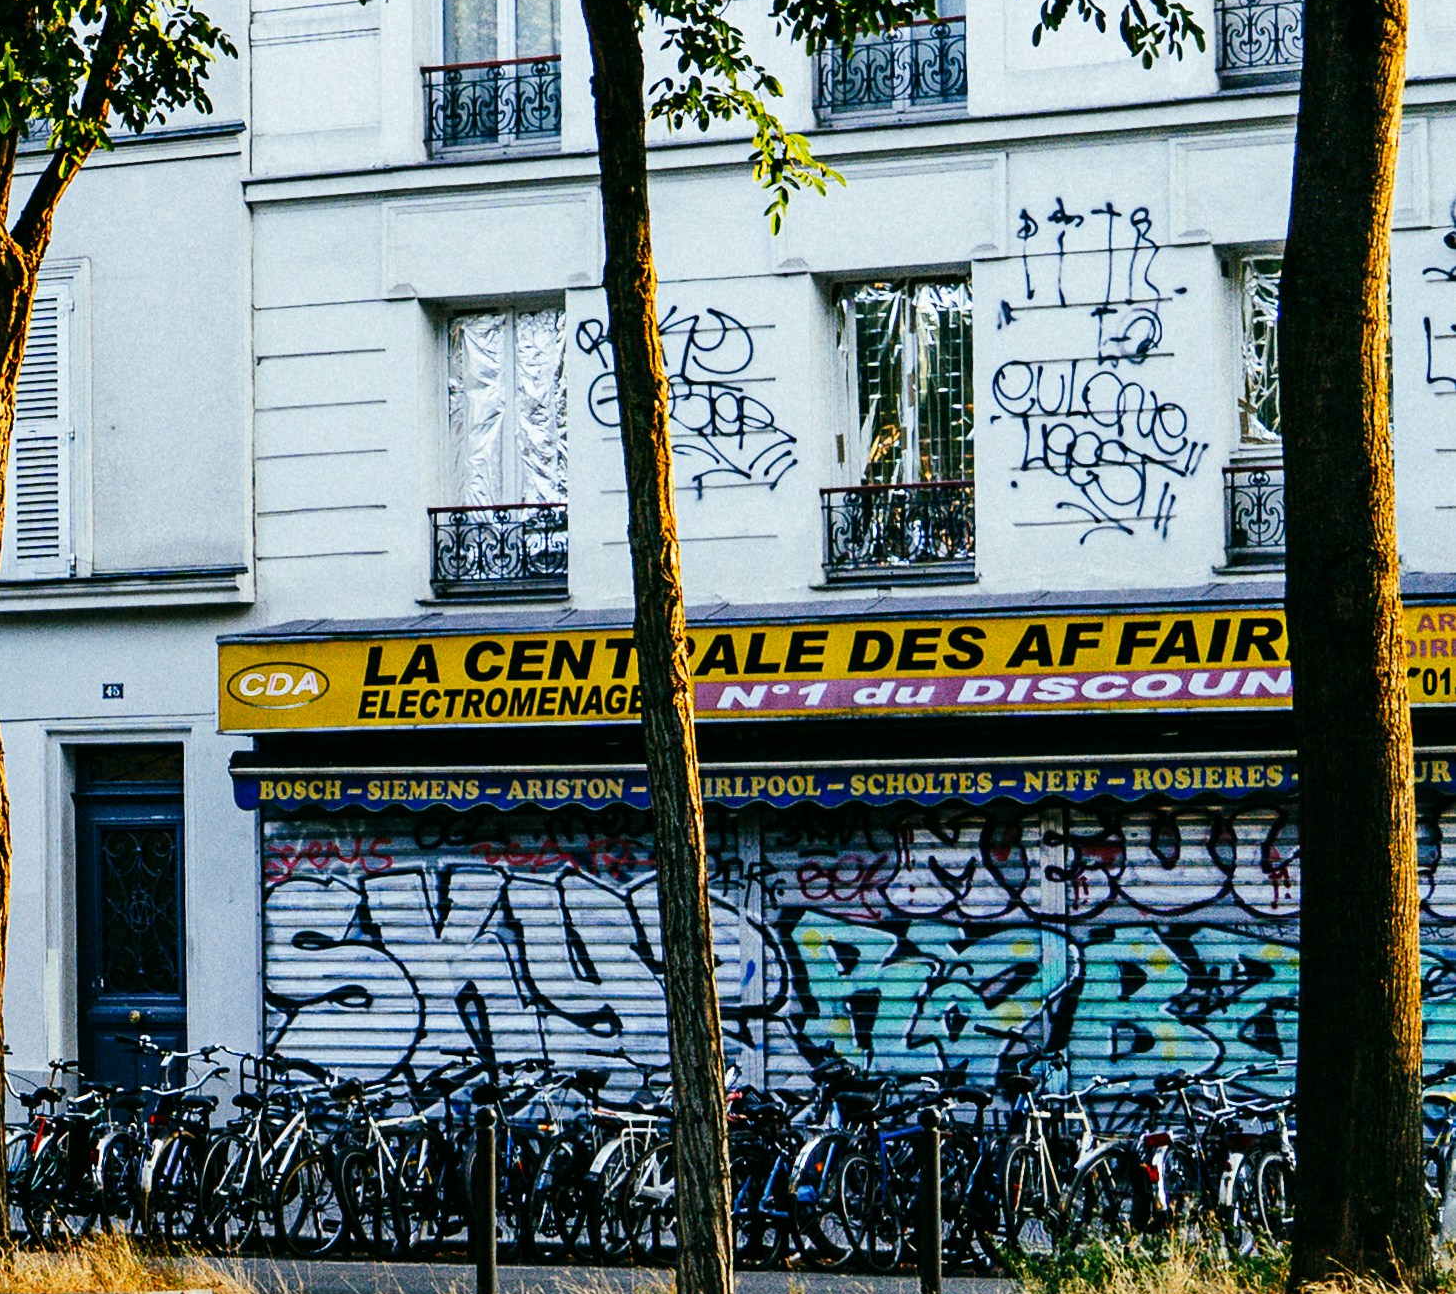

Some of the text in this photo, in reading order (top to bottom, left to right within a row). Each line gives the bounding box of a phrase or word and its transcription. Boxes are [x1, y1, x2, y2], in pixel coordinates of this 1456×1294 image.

[363, 617, 1291, 687] LA CENTALE DES AFFAIR
[1405, 638, 1456, 658] DIR
[239, 671, 319, 697] CDA
[358, 684, 642, 719] ELECTROMENAGE
[852, 681, 937, 705] du
[957, 670, 1292, 703] DISCOUN
[259, 779, 343, 801] BOSCH
[367, 779, 480, 801] SIEMENS
[505, 778, 626, 800] ARISTON
[699, 775, 822, 798] IRLPOOL
[849, 772, 994, 796] SCHOLTES
[1023, 768, 1102, 793] NEFF
[1132, 765, 1285, 790] ROSIERES
